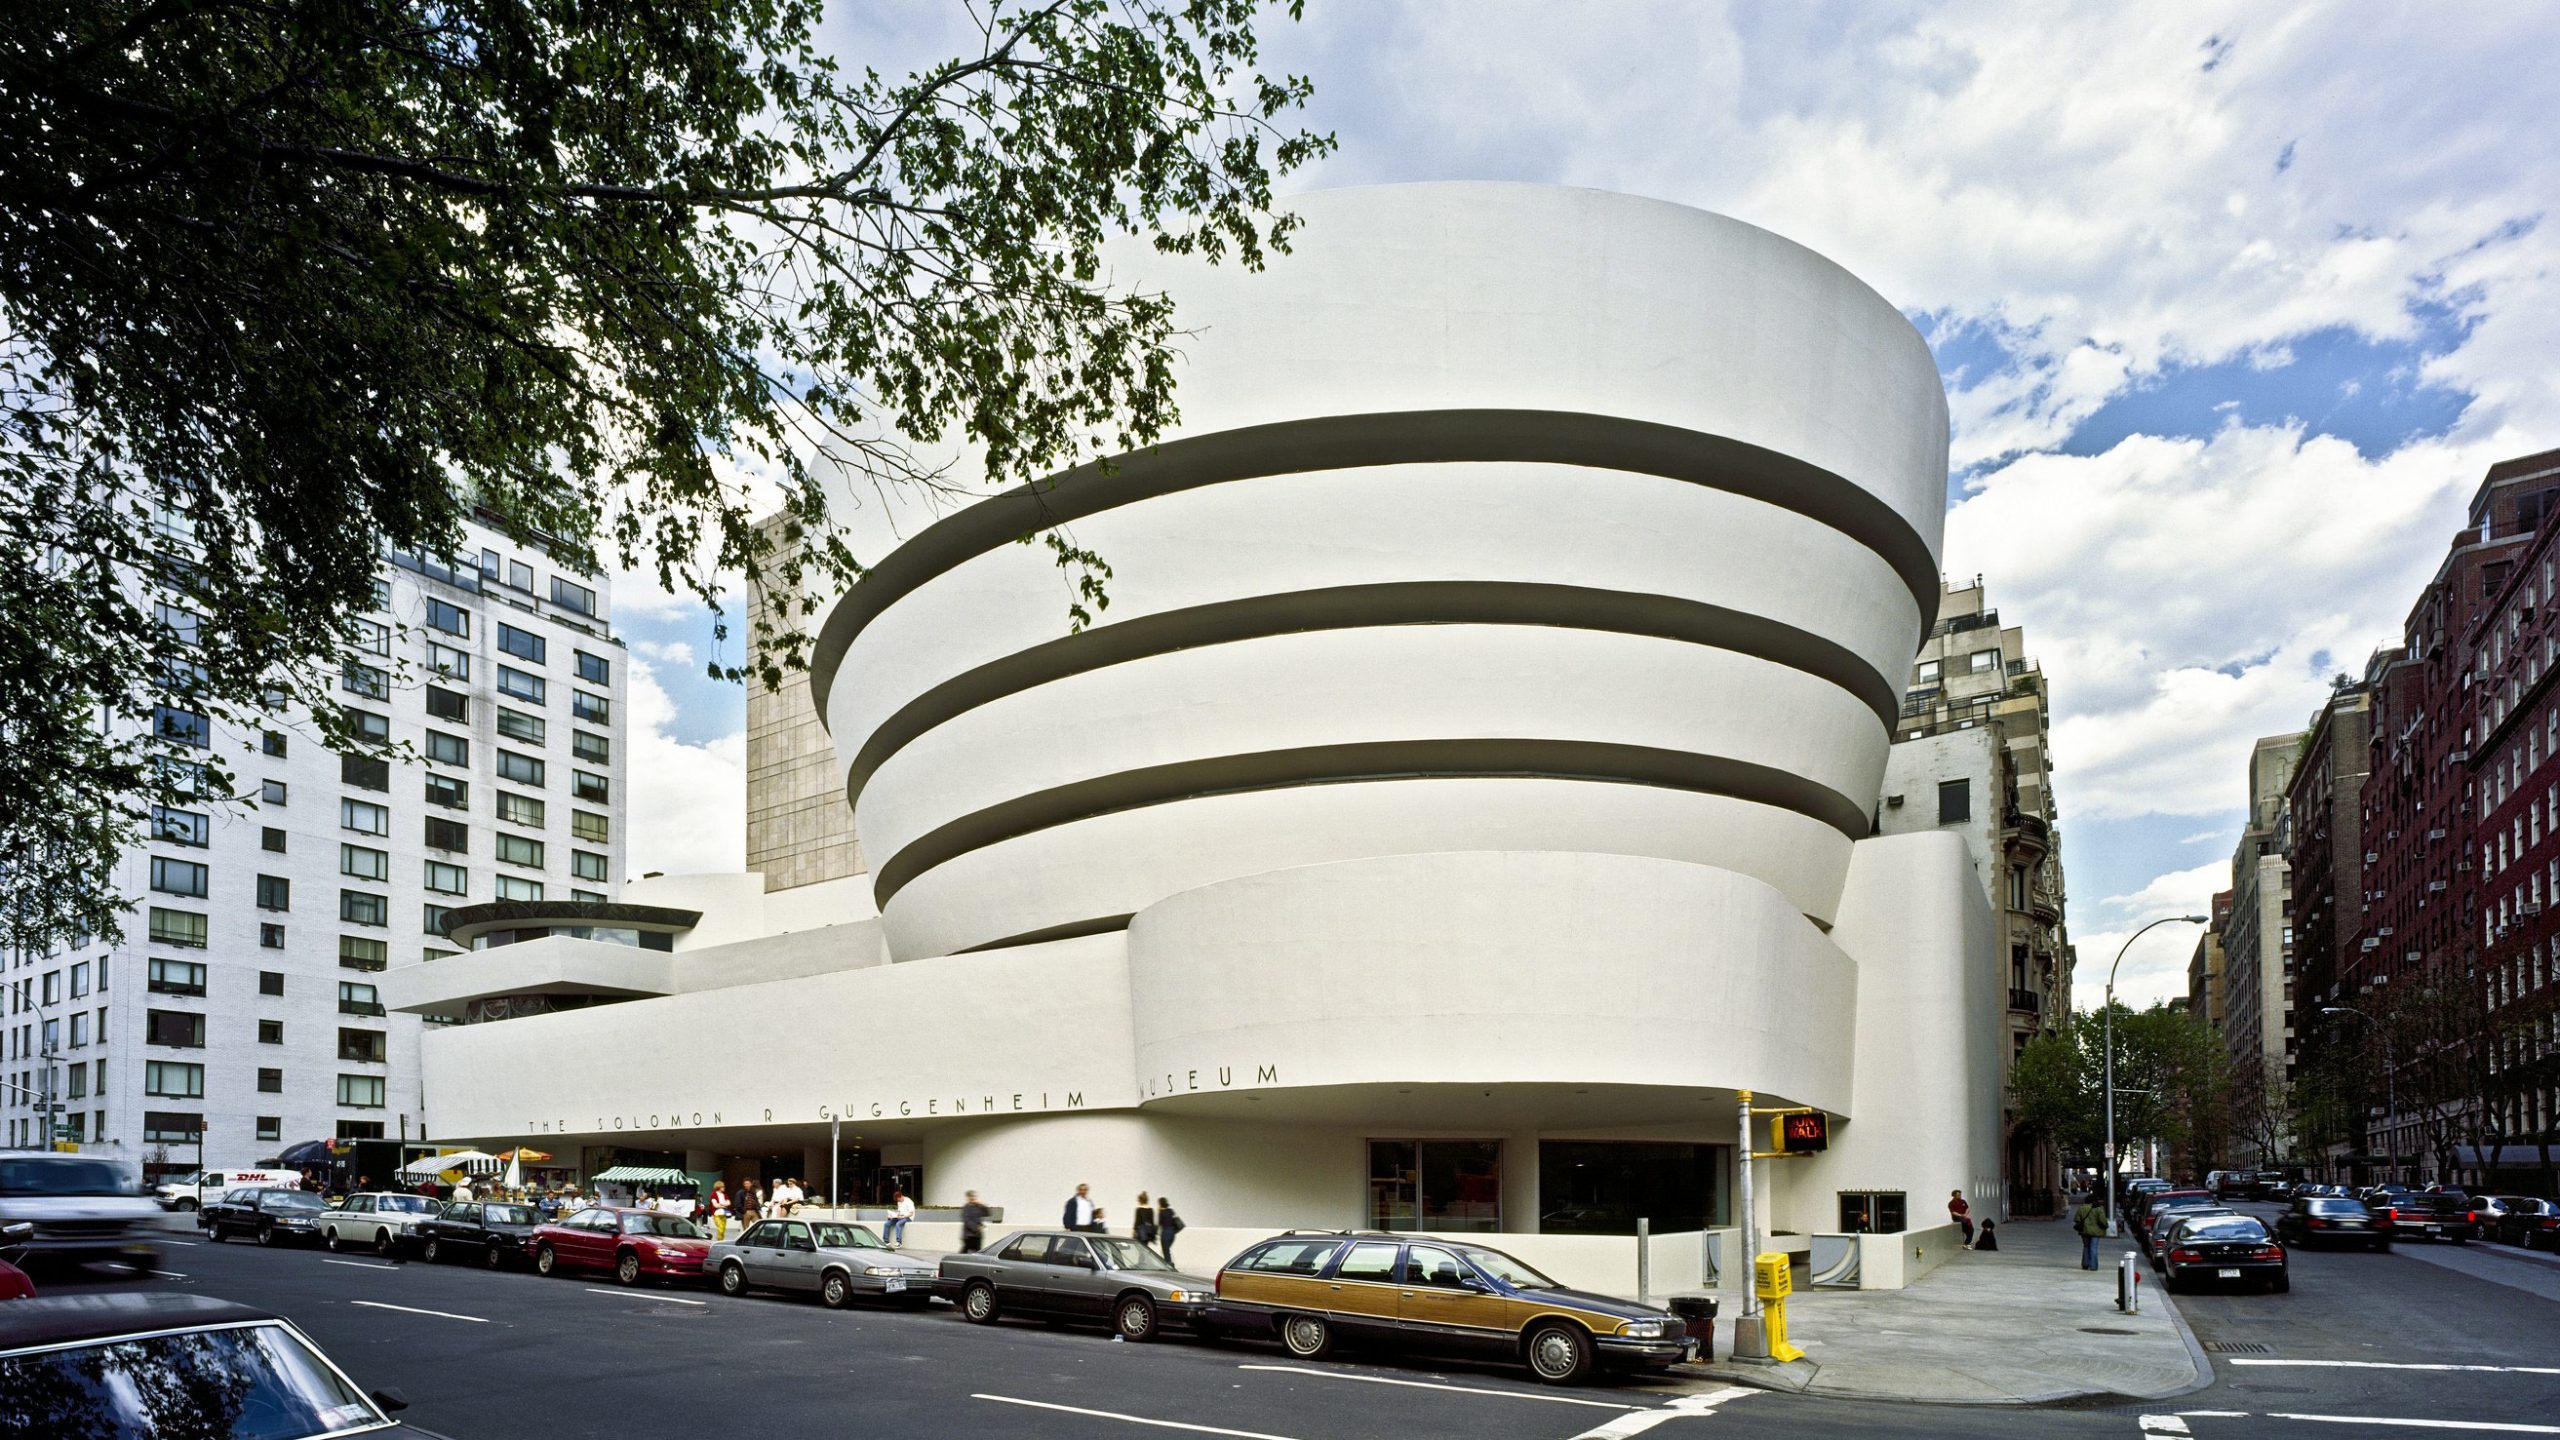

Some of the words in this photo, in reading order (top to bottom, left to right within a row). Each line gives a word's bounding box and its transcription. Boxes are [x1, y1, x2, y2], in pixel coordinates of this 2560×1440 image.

[528, 1119, 565, 1133] THE
[598, 1111, 722, 1130] SOLOMON
[819, 1091, 1084, 1120] GUGGENHEIM
[1789, 1127, 1823, 1138] WALK
[236, 1173, 269, 1182] DHL
